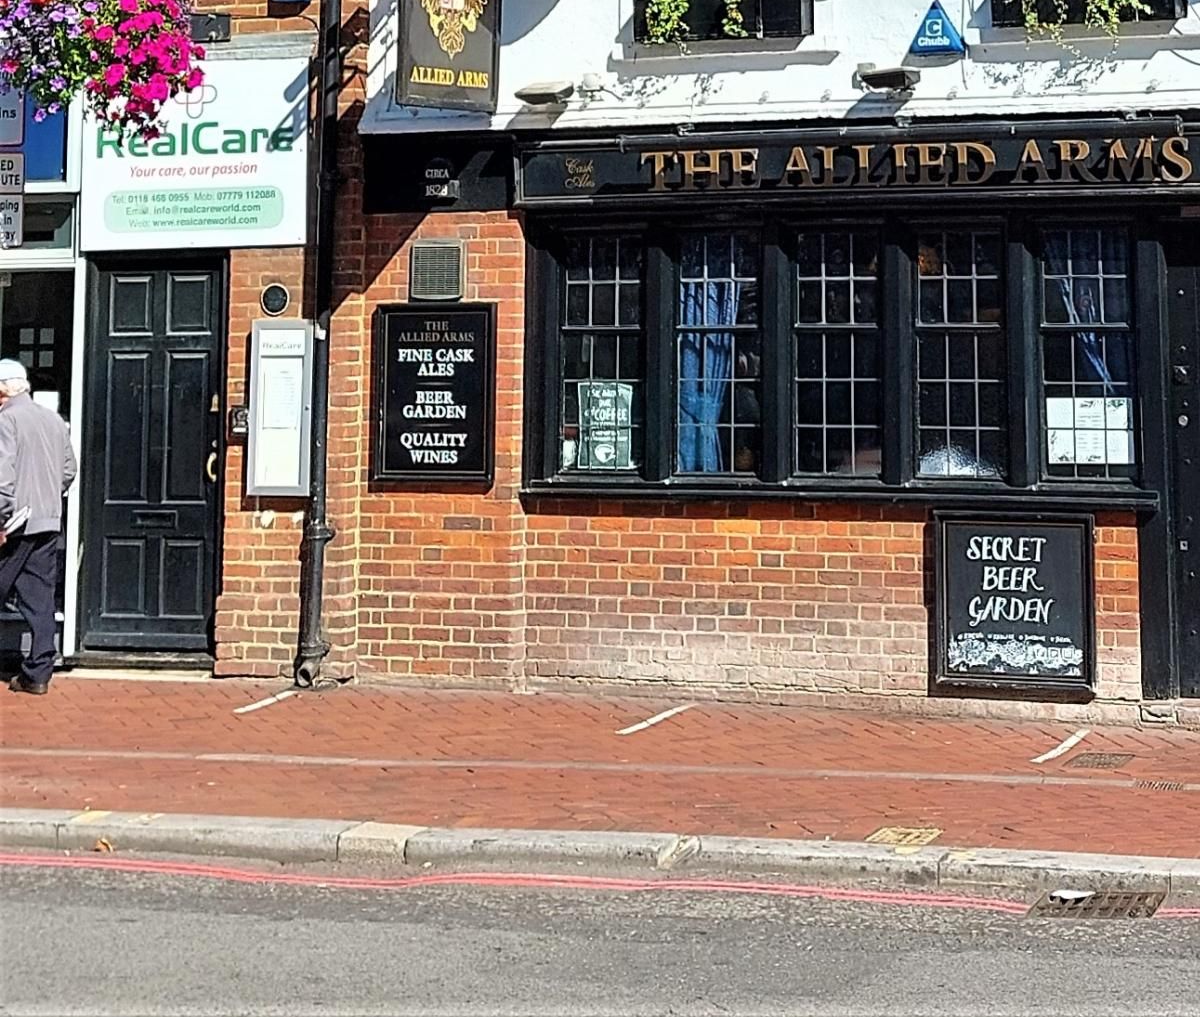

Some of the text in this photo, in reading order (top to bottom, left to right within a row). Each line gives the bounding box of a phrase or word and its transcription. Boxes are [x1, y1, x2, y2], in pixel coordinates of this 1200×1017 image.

[918, 36, 950, 46] Chubb
[411, 65, 489, 88] ALLIED ARMS
[95, 121, 293, 159] RealCare
[0, 159, 14, 171] ED
[130, 162, 258, 178] Your care, our passion
[640, 136, 1194, 191] THE ALLIED ARMS
[1, 174, 20, 185] UTE
[424, 168, 450, 179] CIRCA
[424, 320, 449, 331] THE
[399, 332, 474, 343] ALLIED ARMS
[398, 349, 474, 362] FINE CASK
[417, 363, 454, 376] ALES
[416, 391, 454, 404] BEER
[402, 405, 467, 419] GARDEN
[400, 433, 468, 449] QUALITY
[409, 450, 458, 464] WINES
[966, 536, 1047, 562] SECRET
[982, 566, 1044, 592] BEER
[968, 596, 1055, 627] GARDEN
